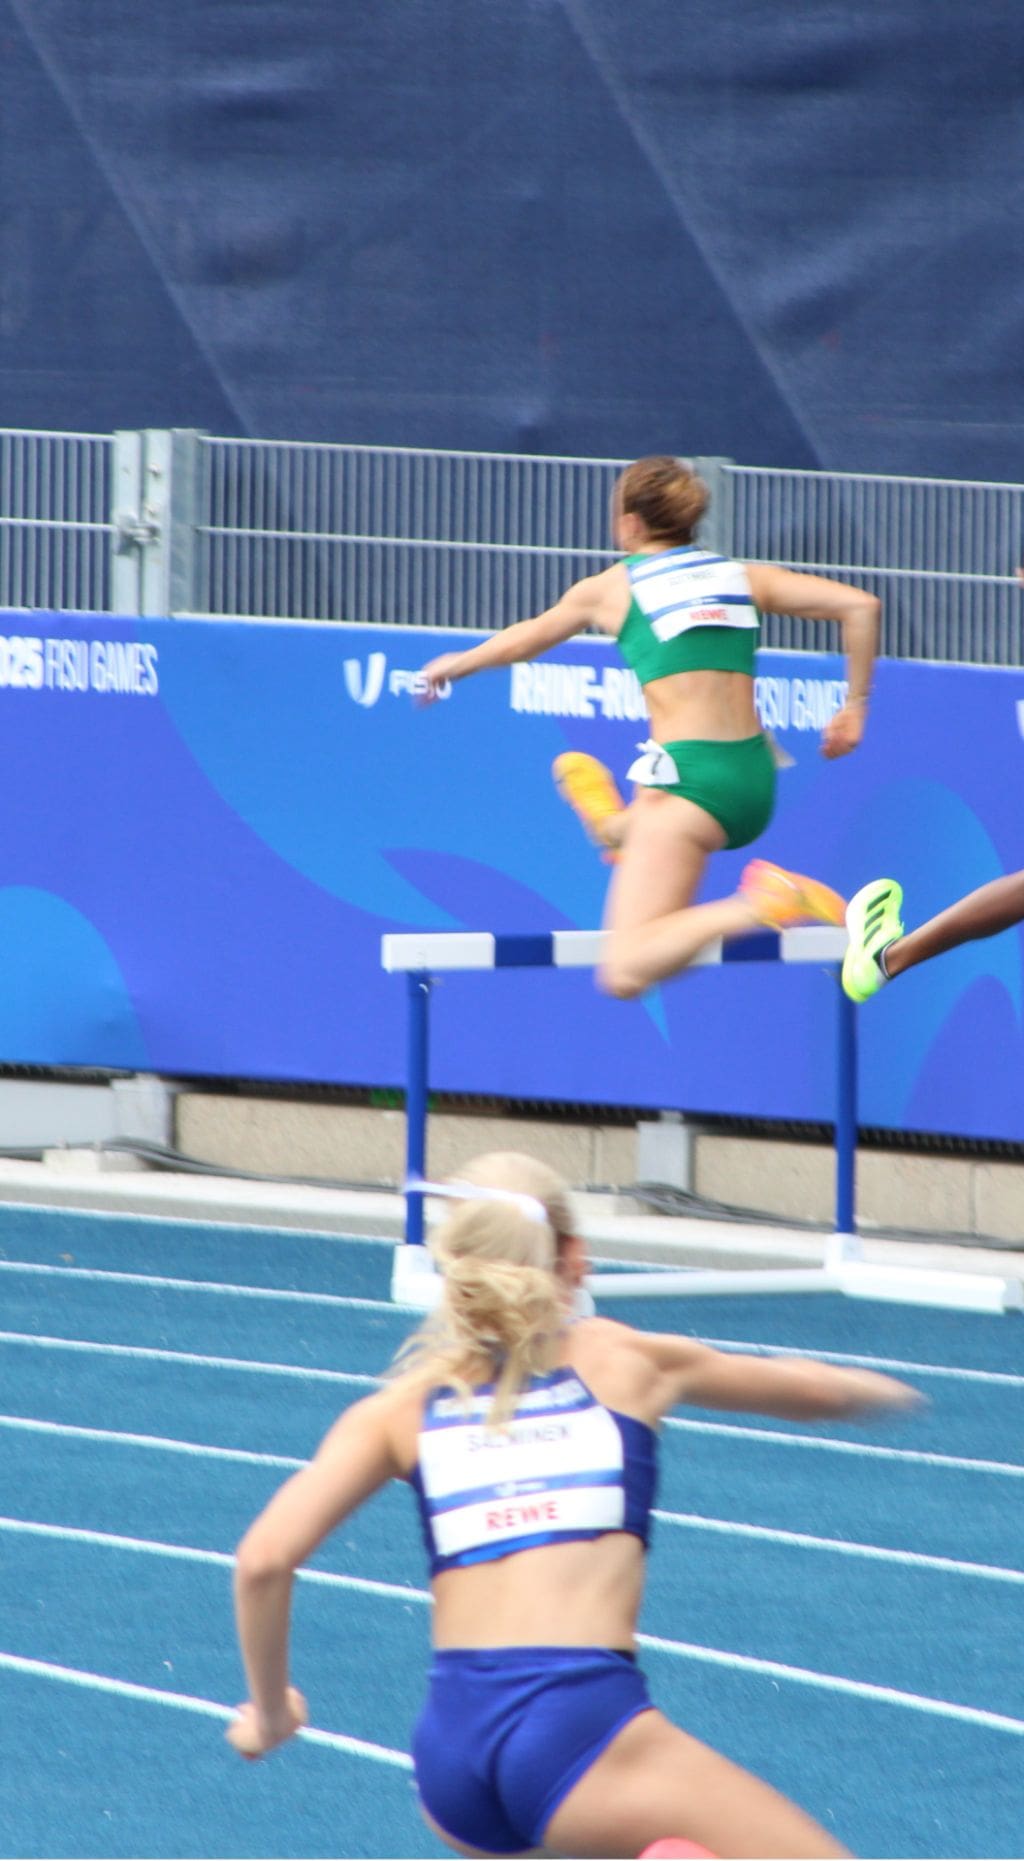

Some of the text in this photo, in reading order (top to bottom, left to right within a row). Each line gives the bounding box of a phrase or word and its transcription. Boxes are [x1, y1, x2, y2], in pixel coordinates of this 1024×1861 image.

[45, 638, 88, 692] FISU
[90, 640, 158, 696] GAMES
[510, 662, 650, 721] RHINE-RU
[486, 1501, 559, 1530] REWE
